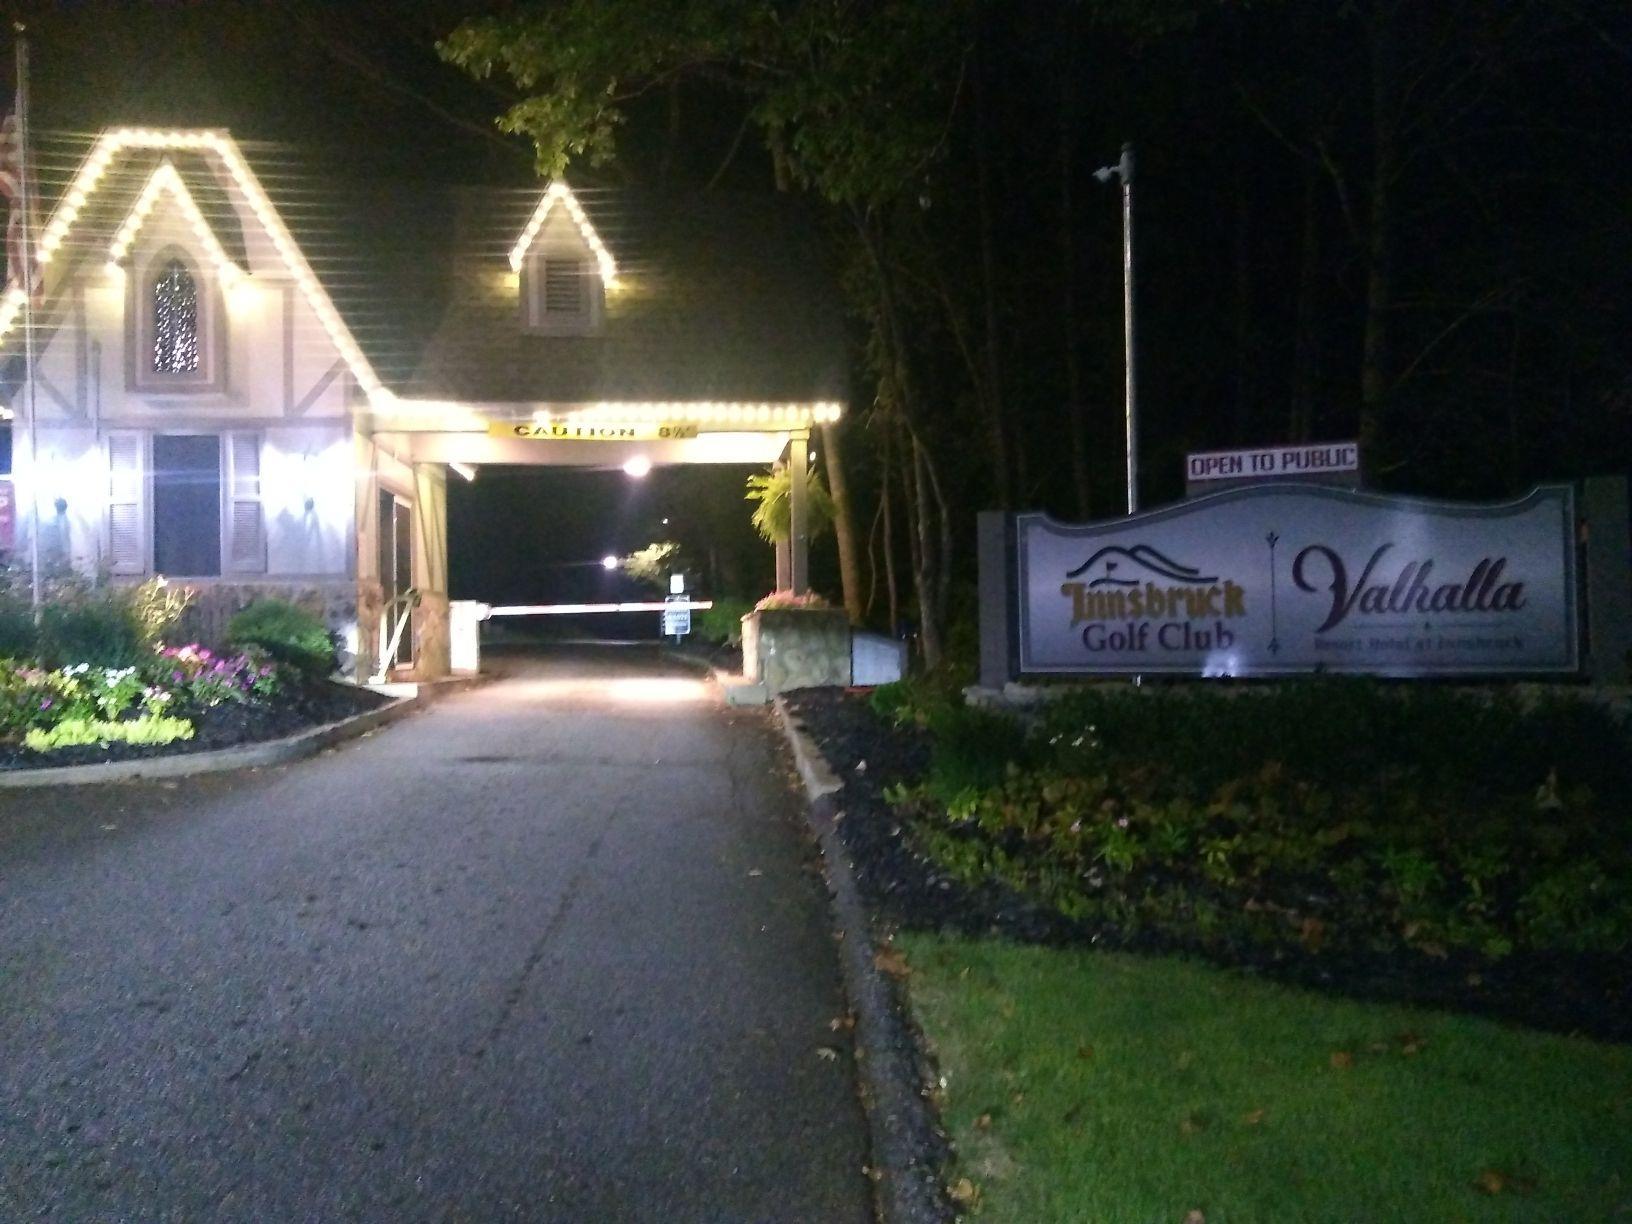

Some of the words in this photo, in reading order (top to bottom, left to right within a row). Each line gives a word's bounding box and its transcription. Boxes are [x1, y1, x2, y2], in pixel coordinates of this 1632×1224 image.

[513, 424, 635, 438] CAUTION
[1190, 455, 1243, 477] OPEN
[1251, 453, 1277, 472] TO
[1281, 447, 1356, 471] PUBLIC
[1060, 579, 1246, 628] Innsbruck
[1292, 542, 1527, 634] Valhalla
[1082, 621, 1149, 651] Golf
[1157, 620, 1235, 650] Club
